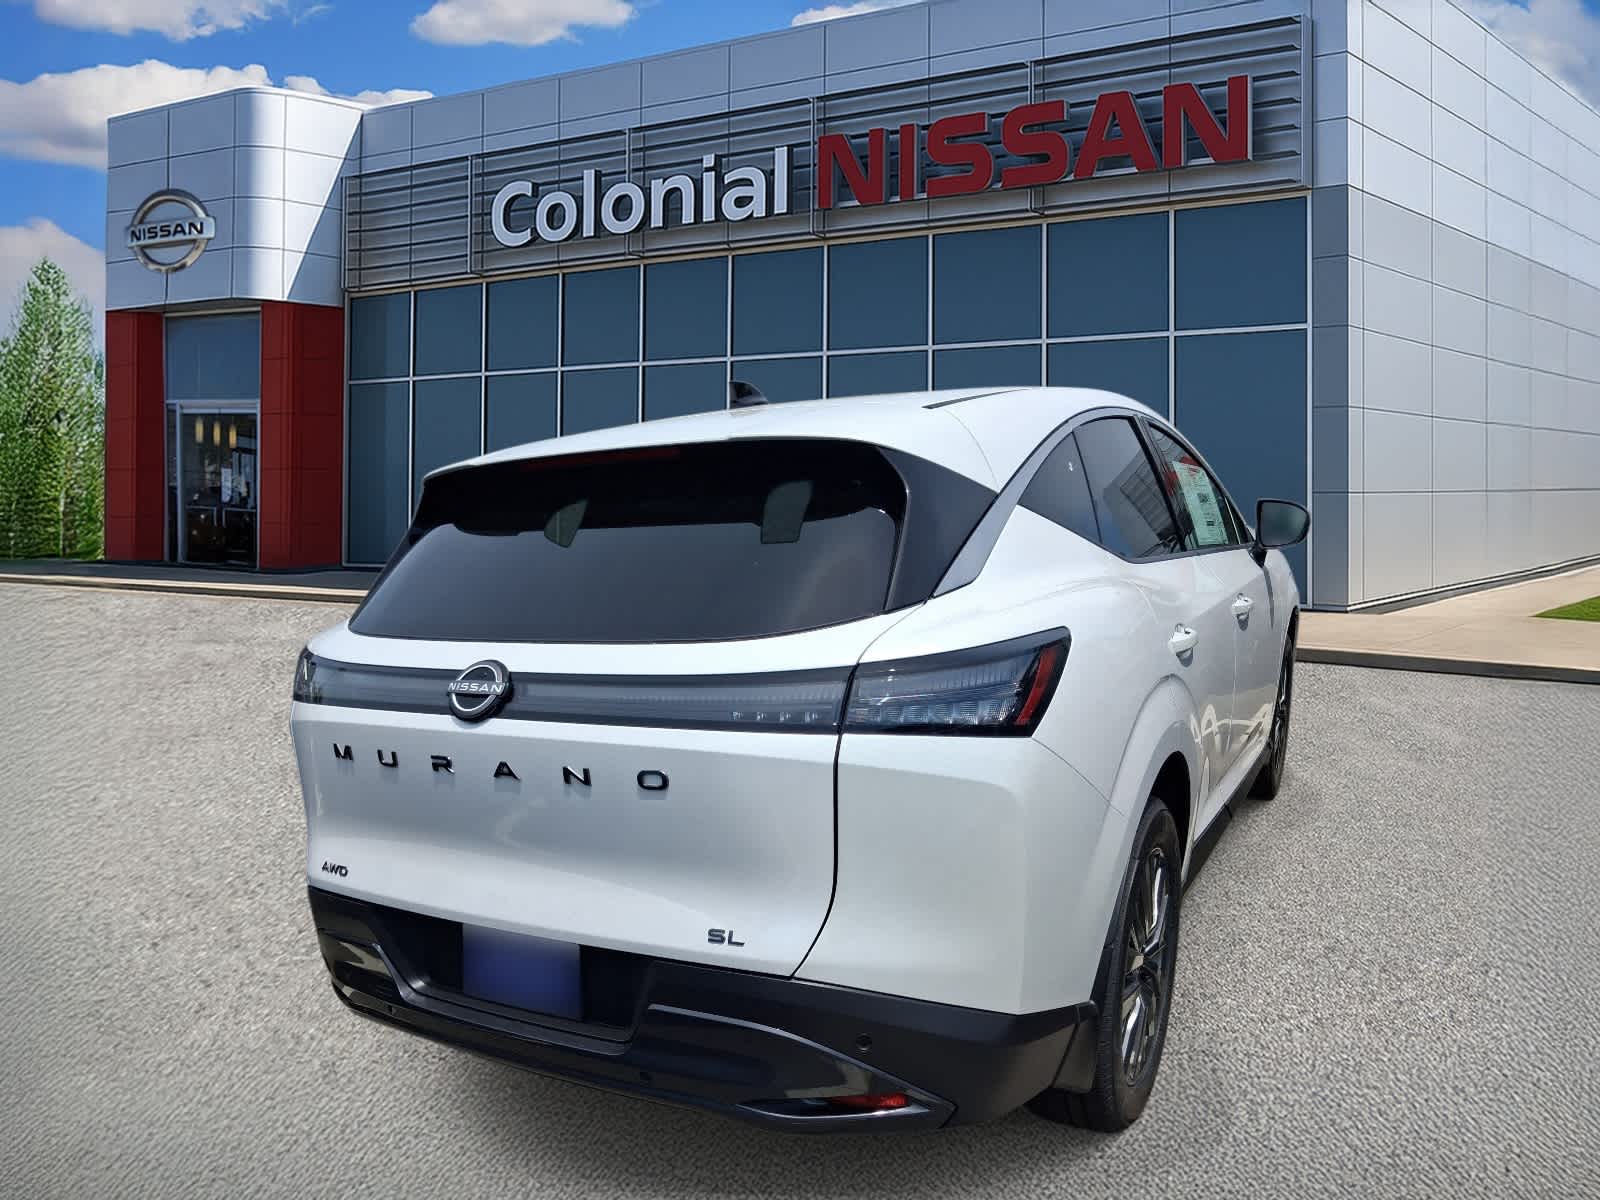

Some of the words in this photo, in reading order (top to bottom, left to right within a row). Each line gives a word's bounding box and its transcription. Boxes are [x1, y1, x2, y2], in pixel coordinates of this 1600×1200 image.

[491, 146, 788, 248] Colonial
[818, 75, 1253, 210] NISSAN
[130, 221, 204, 242] NISSAN
[448, 681, 504, 694] NISSAN
[333, 743, 669, 791] MURANO
[321, 861, 349, 878] AWD
[707, 928, 745, 947] SL
